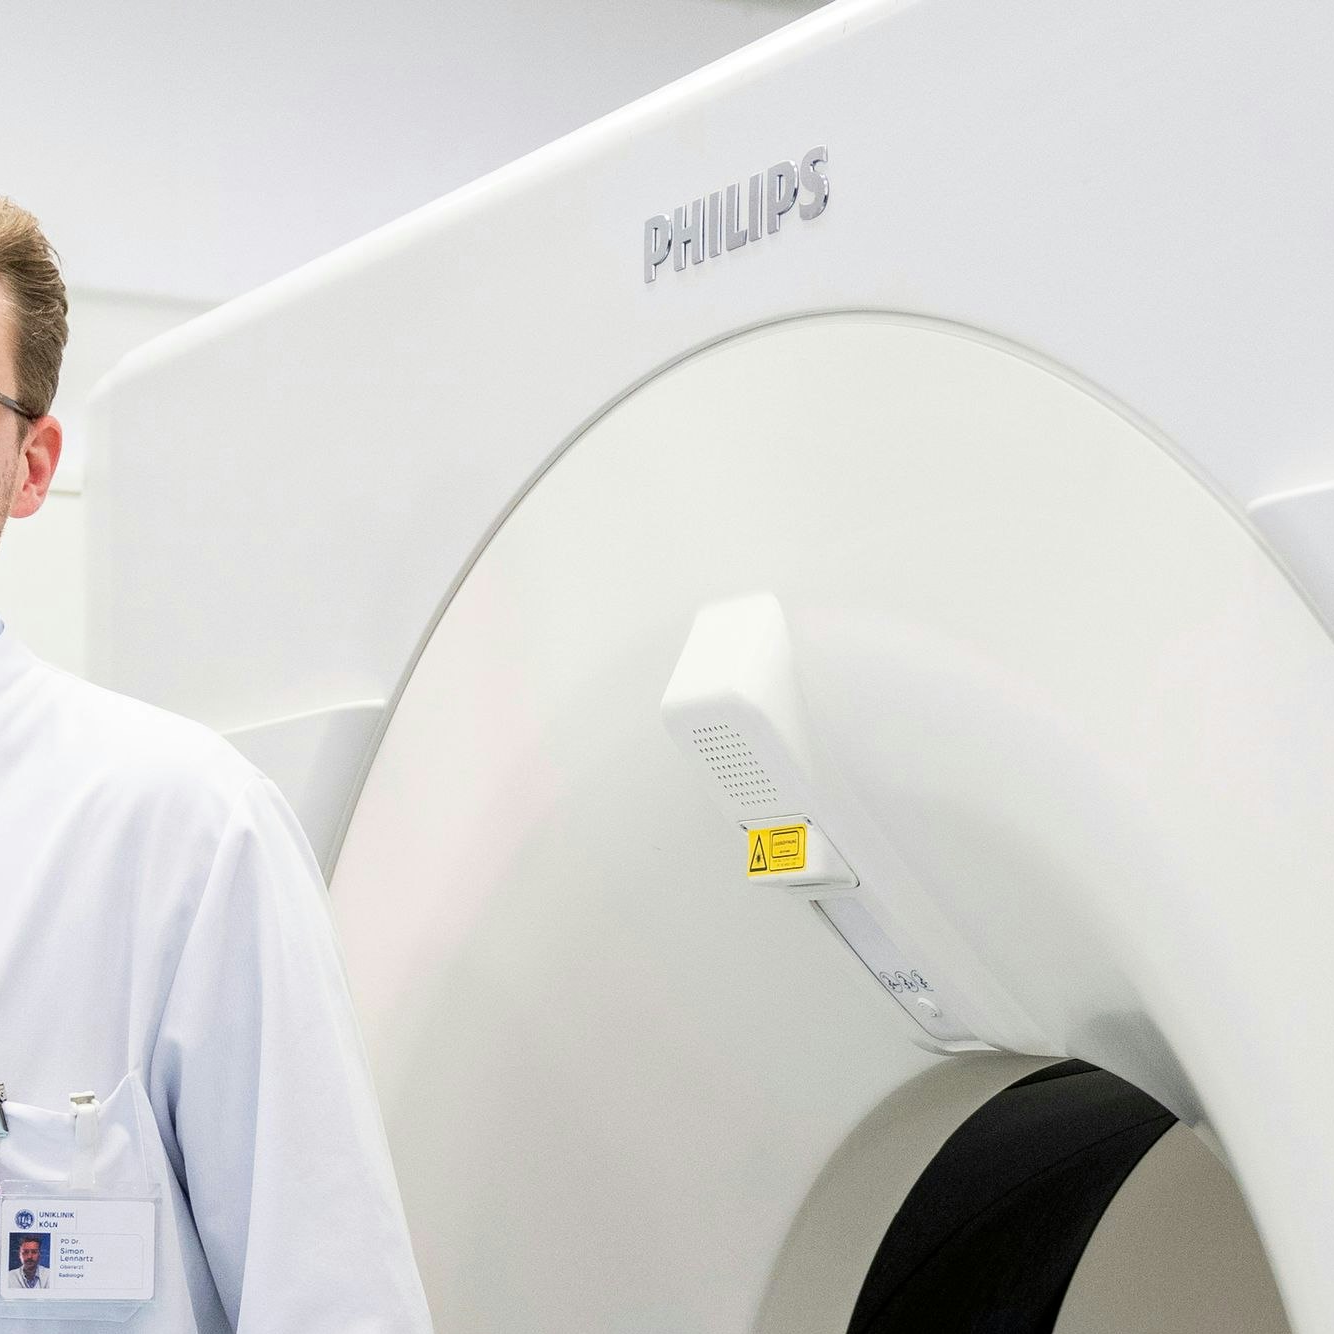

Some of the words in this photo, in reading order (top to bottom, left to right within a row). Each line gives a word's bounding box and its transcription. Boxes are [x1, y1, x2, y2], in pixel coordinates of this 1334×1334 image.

[644, 144, 830, 284] PHILIPS
[38, 1210, 75, 1218] UNIKLINIK
[38, 1220, 58, 1228] KÖLN
